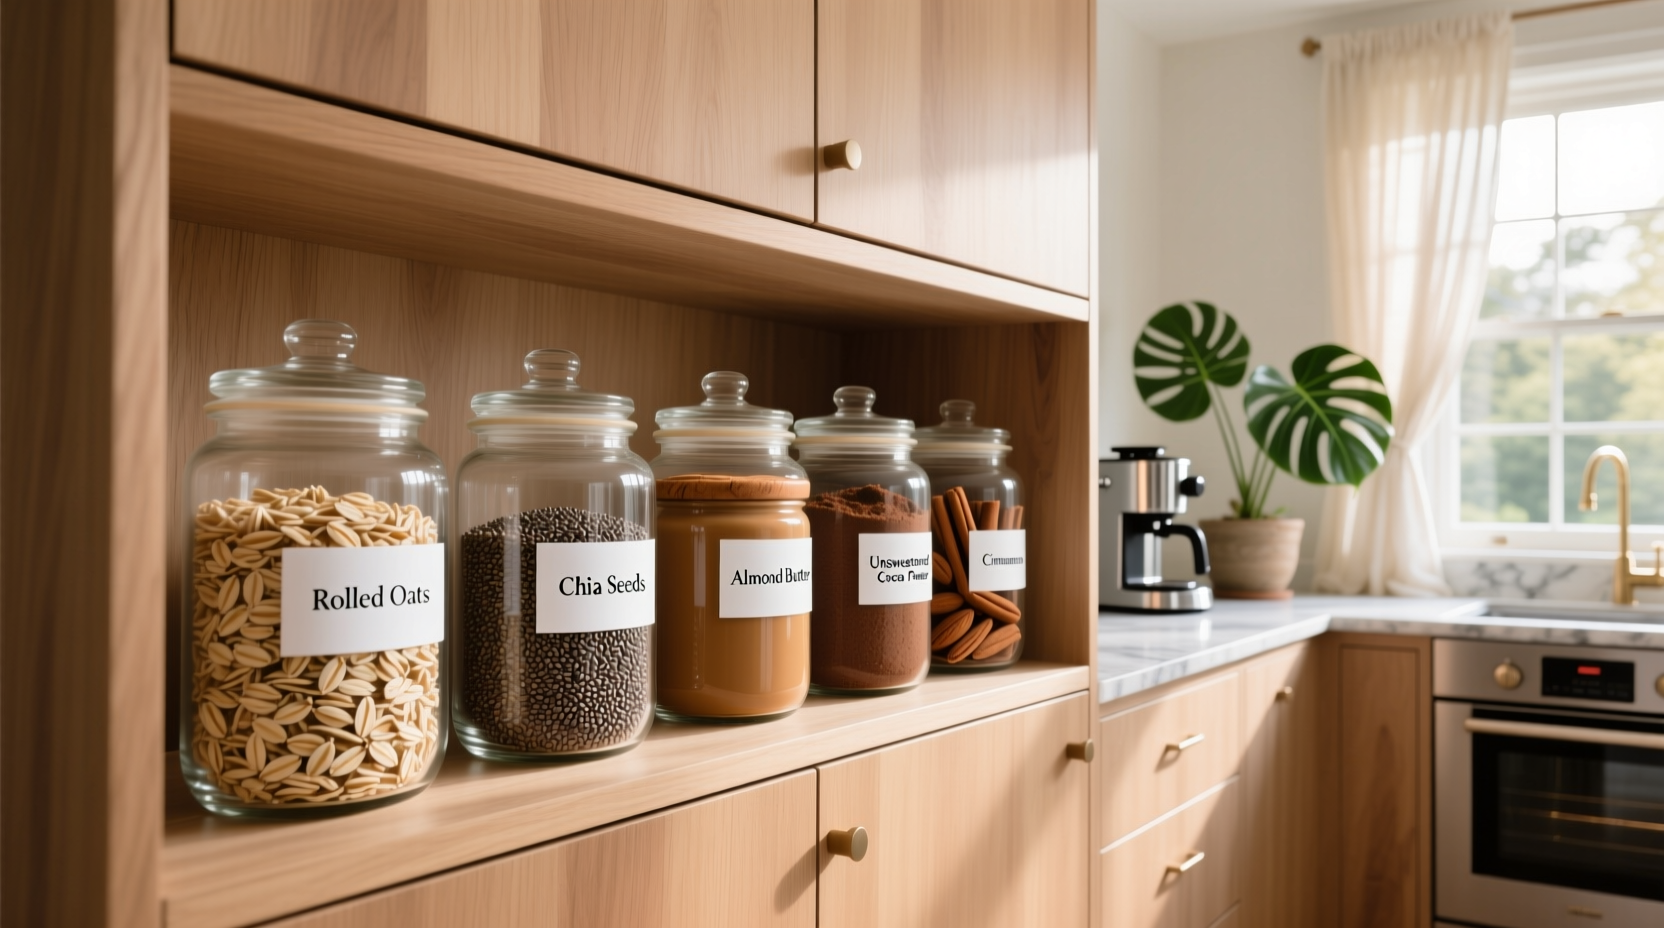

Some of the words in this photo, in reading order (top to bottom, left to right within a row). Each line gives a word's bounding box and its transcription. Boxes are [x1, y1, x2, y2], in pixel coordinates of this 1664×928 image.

[558, 576, 602, 597] Chia
[607, 573, 646, 595] Seeds
[730, 568, 783, 586] Almond
[312, 585, 384, 611] Rolled
[390, 585, 430, 607] Oats
